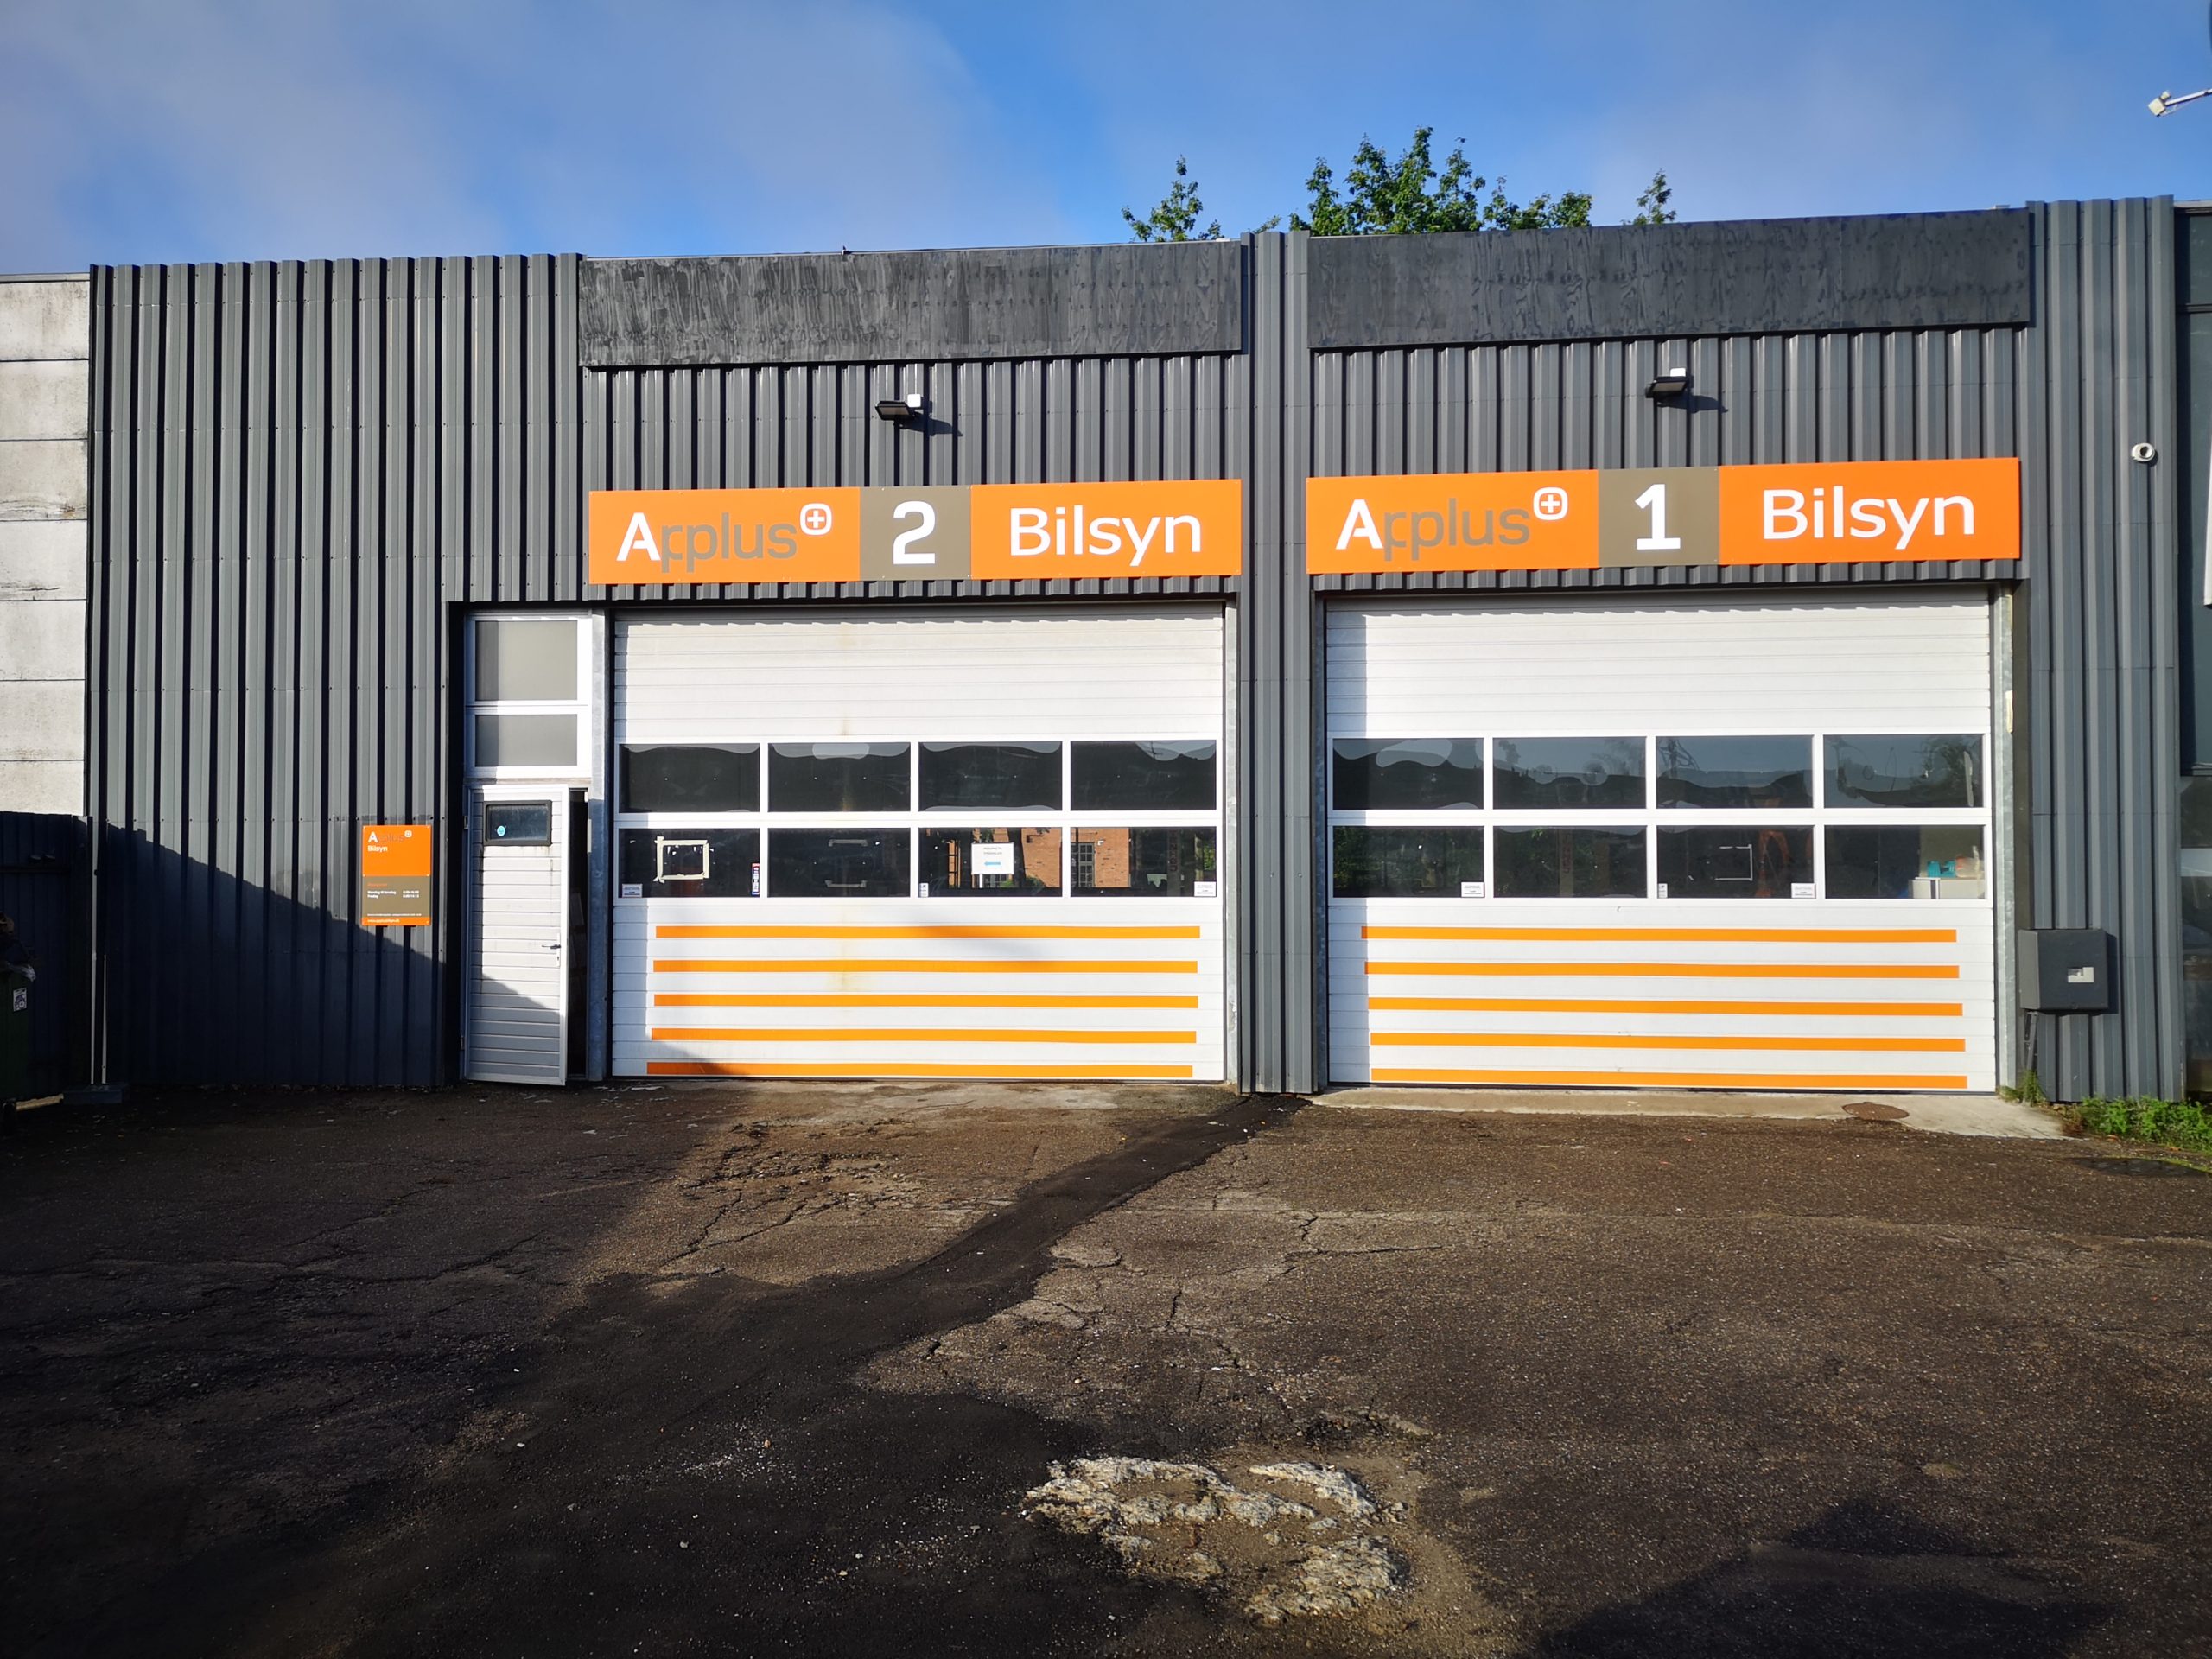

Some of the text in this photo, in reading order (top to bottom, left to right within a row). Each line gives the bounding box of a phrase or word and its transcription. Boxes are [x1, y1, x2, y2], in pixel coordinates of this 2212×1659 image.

[893, 500, 936, 565] 2
[1010, 504, 1202, 567] Bilsyn
[1635, 483, 1681, 550] 1
[1763, 485, 1975, 550] Bilsyn
